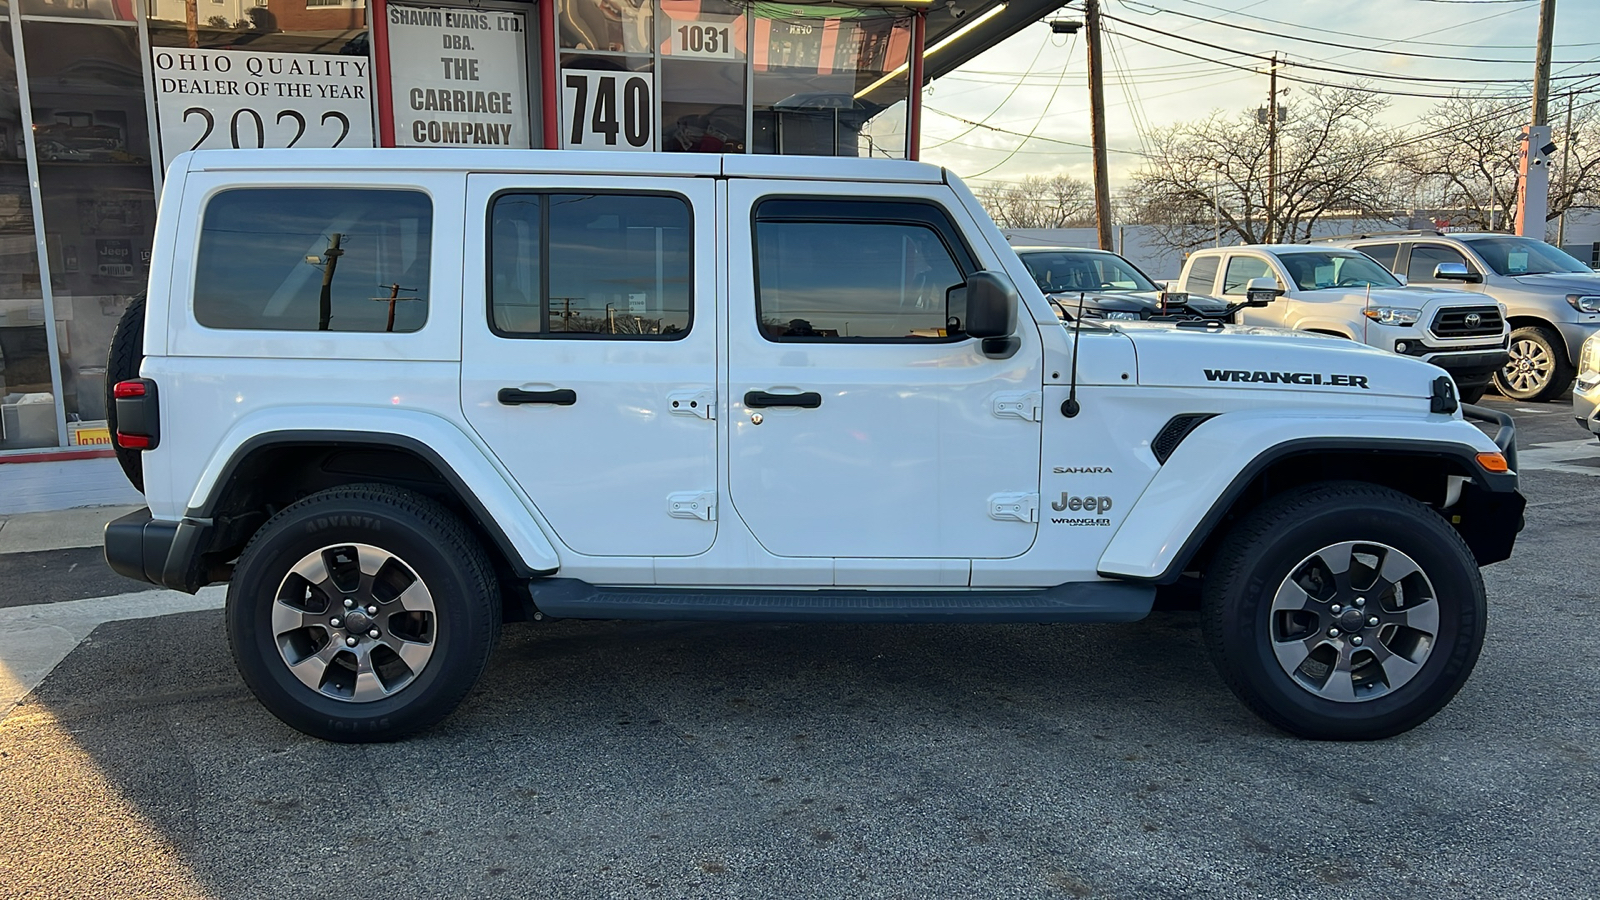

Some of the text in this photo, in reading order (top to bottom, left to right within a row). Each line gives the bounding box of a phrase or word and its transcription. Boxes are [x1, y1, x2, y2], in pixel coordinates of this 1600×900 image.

[390, 9, 442, 28] SHAWN
[497, 16, 523, 32] LTD.
[443, 34, 475, 51] DBA.
[678, 25, 729, 53] 1031
[156, 53, 367, 78] OHIO QUALITY
[440, 57, 480, 81] THE
[161, 78, 366, 100] DEALER OF THE YEAR
[409, 88, 513, 114] CARRIAGE
[566, 75, 650, 147] 740
[182, 107, 350, 149] 2022
[412, 120, 513, 146] COMPANY
[100, 246, 129, 257] Jeep
[1203, 369, 1370, 390] WRANGLER
[1053, 466, 1113, 474] SAHARA
[1051, 491, 1113, 515] Jeep
